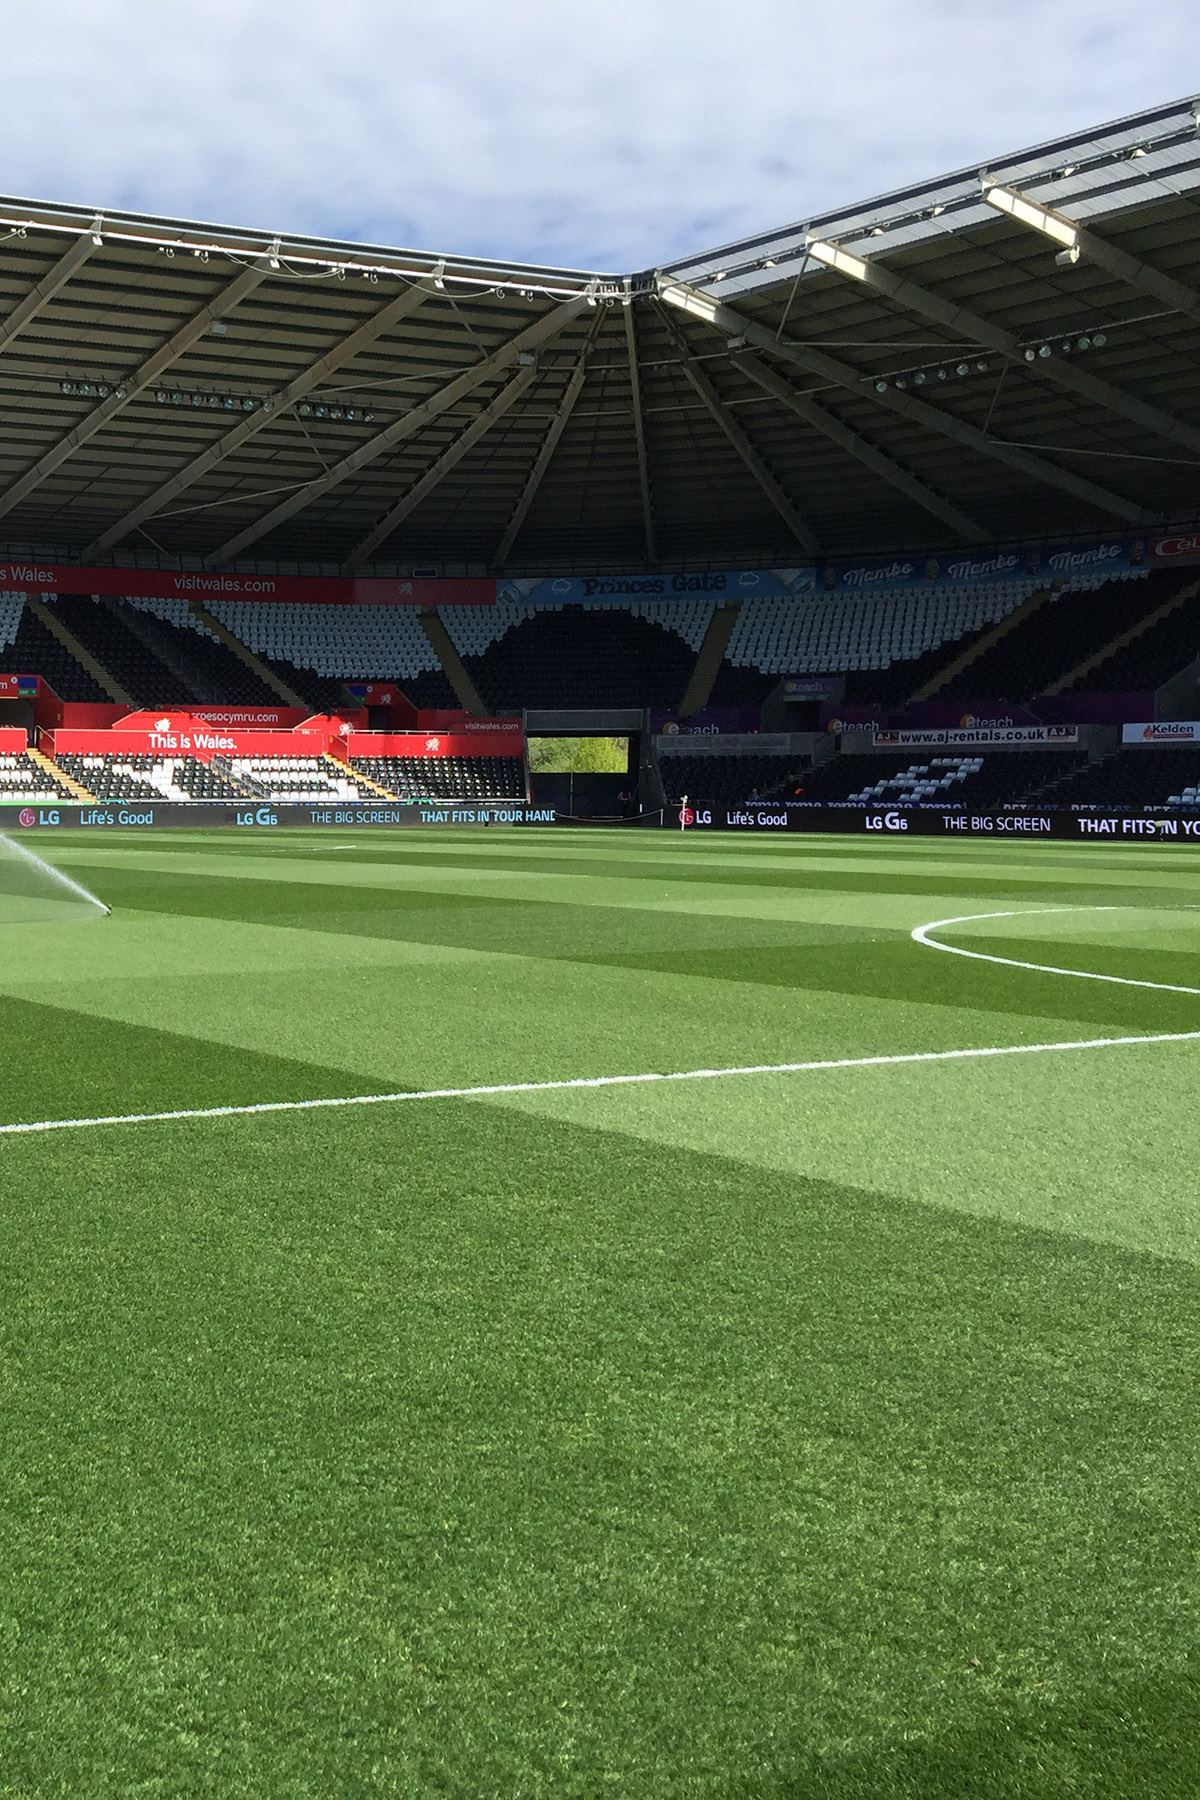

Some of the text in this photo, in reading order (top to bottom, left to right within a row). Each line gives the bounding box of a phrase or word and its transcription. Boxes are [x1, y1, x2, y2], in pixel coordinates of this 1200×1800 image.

[10, 566, 58, 583] Wales.
[174, 575, 276, 592] visitwales.com
[582, 573, 728, 596] Princes Gate
[148, 733, 238, 750] This is Wales.
[901, 729, 1045, 744] www.aj-rentals.co.uk
[39, 810, 60, 825] LG
[80, 810, 153, 825] Life's Good
[236, 813, 253, 825] LG
[310, 811, 400, 824] THE BIG SCREEN
[420, 810, 449, 823] THAT
[452, 810, 475, 822] FITS
[477, 810, 490, 822] IN
[695, 811, 712, 824] LG
[726, 811, 787, 826] Life's Good
[865, 816, 883, 829] LG
[942, 816, 1051, 832] THE BIG SCREEN
[1077, 819, 1118, 833] THAT
[1122, 819, 1156, 834] FITS
